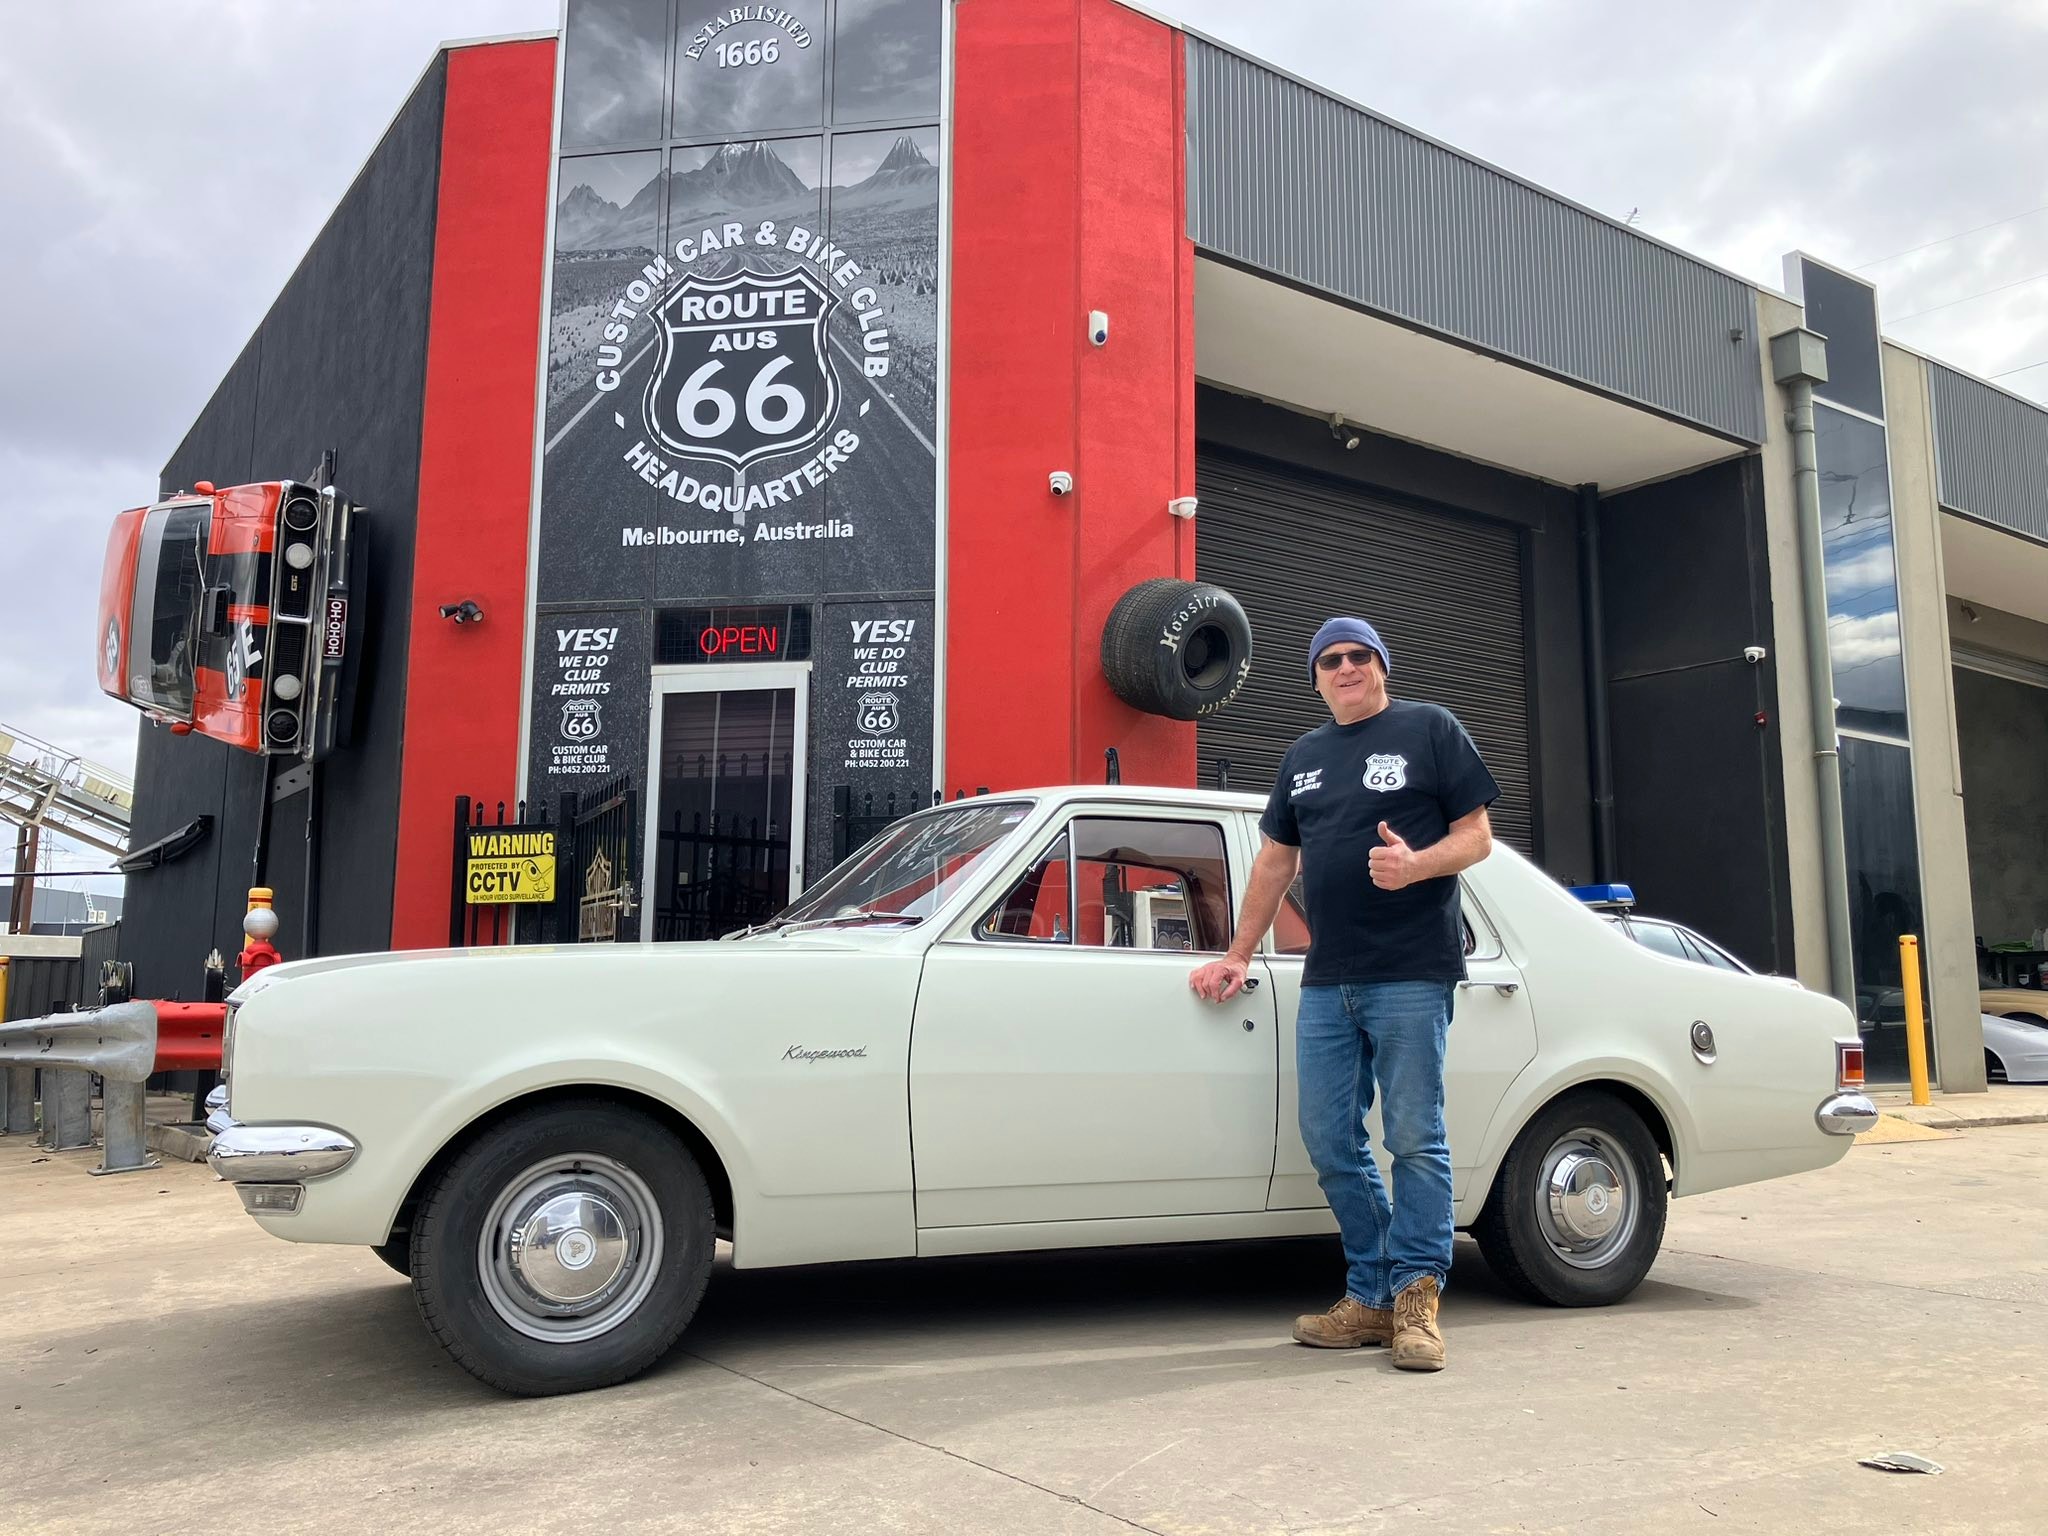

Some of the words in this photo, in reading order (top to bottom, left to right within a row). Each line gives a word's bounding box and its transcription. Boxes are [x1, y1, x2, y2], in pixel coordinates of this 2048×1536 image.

[684, 4, 812, 62] ESTABLISHED
[714, 37, 780, 68] 1666
[595, 253, 674, 393] CUSTOM
[675, 222, 745, 263] CAR
[754, 220, 778, 247] &
[785, 226, 862, 289] BIKE
[851, 286, 890, 379] CLUB
[681, 289, 807, 322] ROUTE
[708, 330, 778, 353] AUS
[676, 355, 806, 439] 66
[623, 429, 859, 513] HEADQUARTERS
[622, 527, 746, 548] Melbourne,
[754, 519, 854, 542] Australia
[850, 619, 915, 643] YES!
[239, 617, 263, 669] E
[556, 628, 619, 652] YES!
[699, 626, 778, 655] OPEN
[558, 656, 582, 668] WE
[584, 654, 609, 667] DO
[853, 648, 878, 661] WE
[881, 647, 905, 660] DO
[564, 669, 601, 682] CLUB
[859, 661, 898, 674] CLUB
[551, 682, 611, 696] PERMITS
[846, 675, 908, 688] PERMITS
[567, 717, 594, 735] 66
[864, 711, 892, 728] 66
[551, 745, 588, 755] CUSTOM
[589, 745, 608, 754] CAR
[848, 739, 886, 749] CUSTOM
[887, 739, 907, 748] CAR
[553, 755, 561, 765] &
[562, 755, 582, 764] BIKE
[583, 754, 606, 764] CLUB
[849, 749, 857, 758] &
[859, 749, 880, 758] BIKE
[881, 748, 905, 758] CLUB
[548, 766, 561, 774] PH:
[561, 765, 581, 774] 0452
[581, 765, 597, 773] 200
[597, 764, 611, 773] 221
[844, 760, 858, 768] PH:
[858, 759, 879, 768] 0452
[879, 759, 895, 768] 200
[895, 759, 909, 767] 221
[1370, 771, 1398, 786] 66
[470, 832, 554, 856] WARNING
[471, 862, 508, 871] PROTECTED
[511, 862, 520, 870] BY
[469, 871, 521, 893] CCTV
[494, 893, 508, 901] VIDEO
[509, 892, 545, 900] SURVEILLANCE
[781, 1044, 867, 1065] Kingswood
